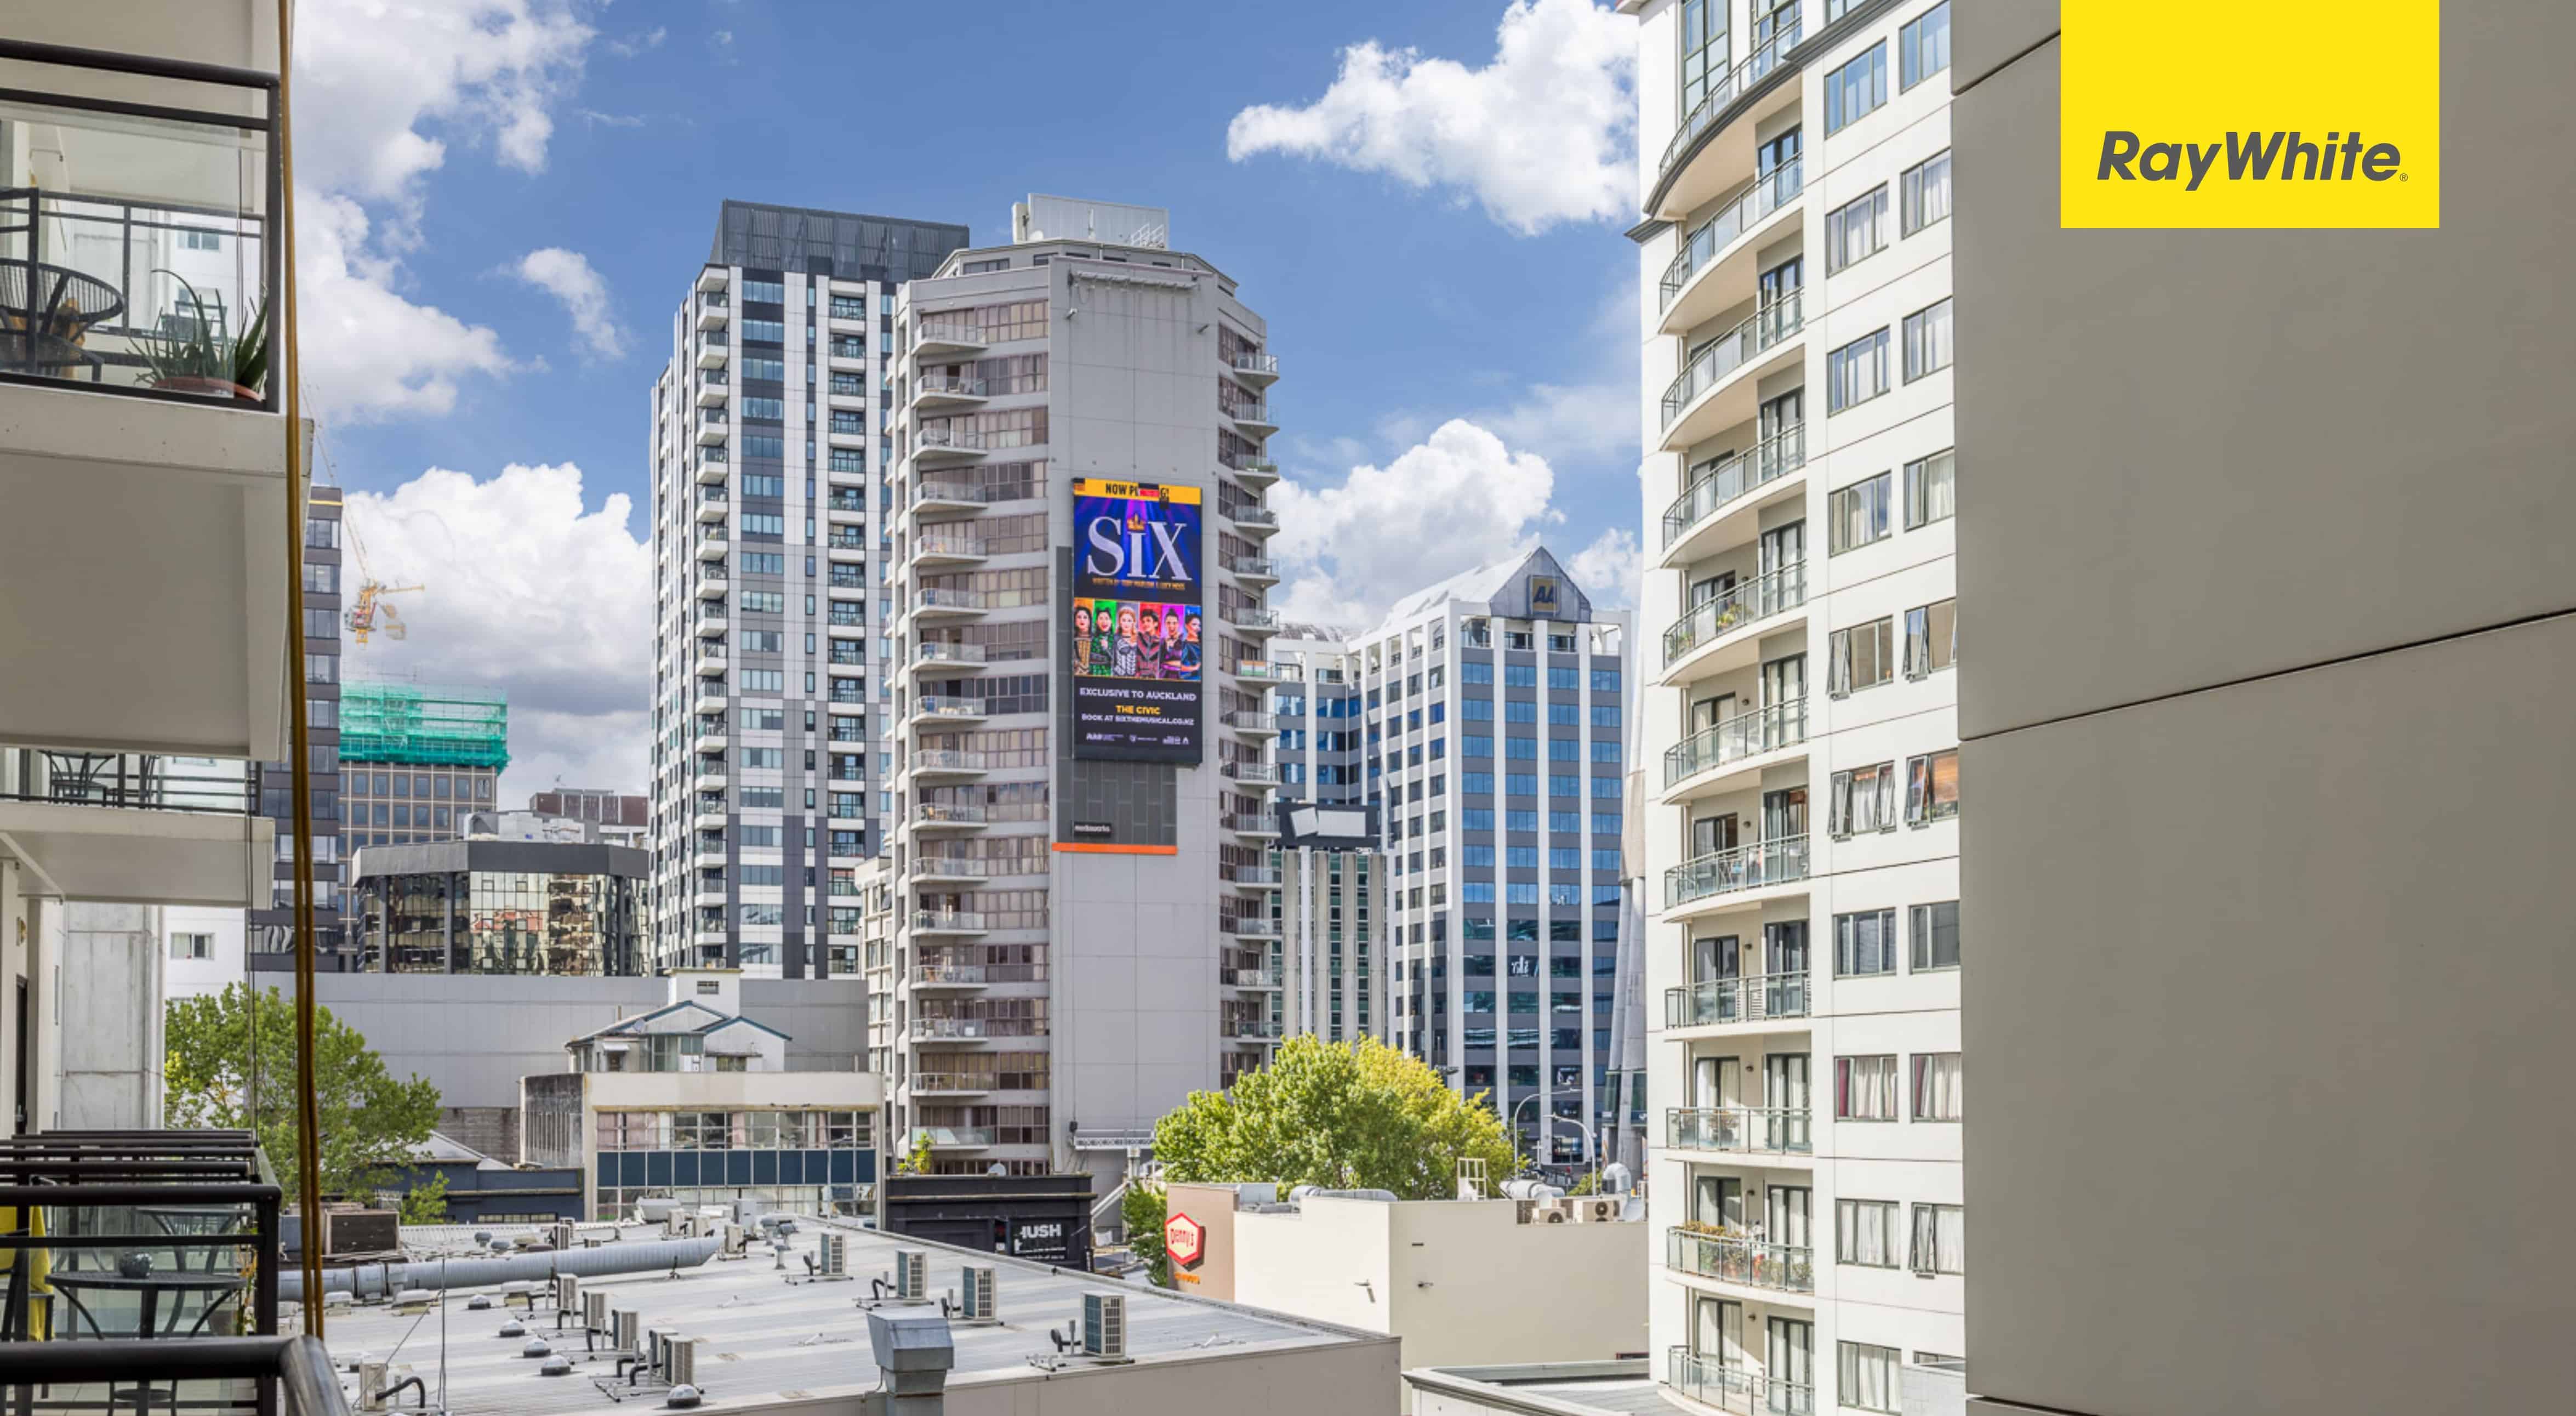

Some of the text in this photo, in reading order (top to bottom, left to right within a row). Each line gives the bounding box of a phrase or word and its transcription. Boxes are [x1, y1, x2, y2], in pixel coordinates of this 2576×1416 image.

[1105, 482, 1127, 496] NOW
[1087, 516, 1193, 581] SIX
[1080, 687, 1196, 702] EXCLUSIVE TO AUCKLAND
[1081, 713, 1102, 721] BOOK
[1115, 705, 1160, 715] THE CIVIC
